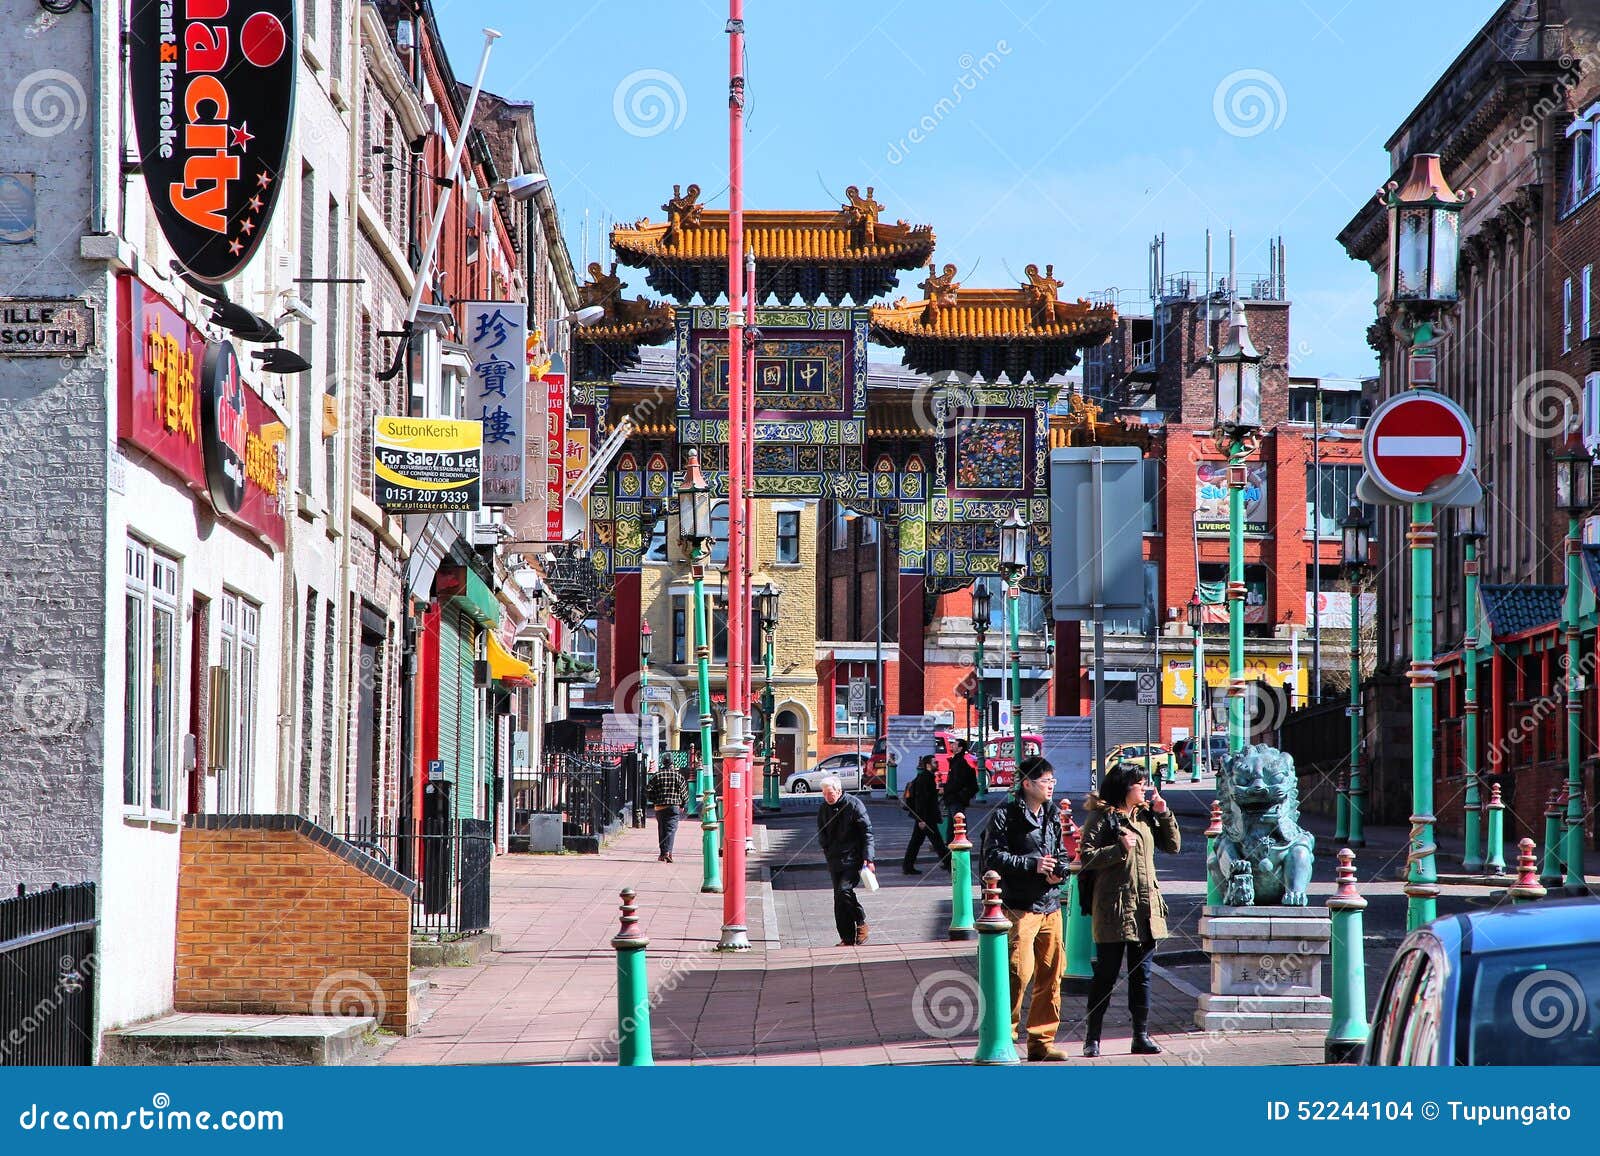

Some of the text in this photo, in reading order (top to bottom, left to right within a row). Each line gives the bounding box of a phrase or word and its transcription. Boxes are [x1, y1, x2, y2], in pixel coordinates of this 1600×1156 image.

[1, 329, 77, 344] SOUTH
[473, 308, 519, 445] 珍寶樓
[387, 422, 458, 438] SuttonKersh
[381, 451, 403, 464] For
[406, 452, 454, 467] Sale/To
[458, 454, 478, 468] Let
[385, 487, 468, 503] 0151 207 9339
[386, 502, 470, 510] www.suttonkersh.co.uk
